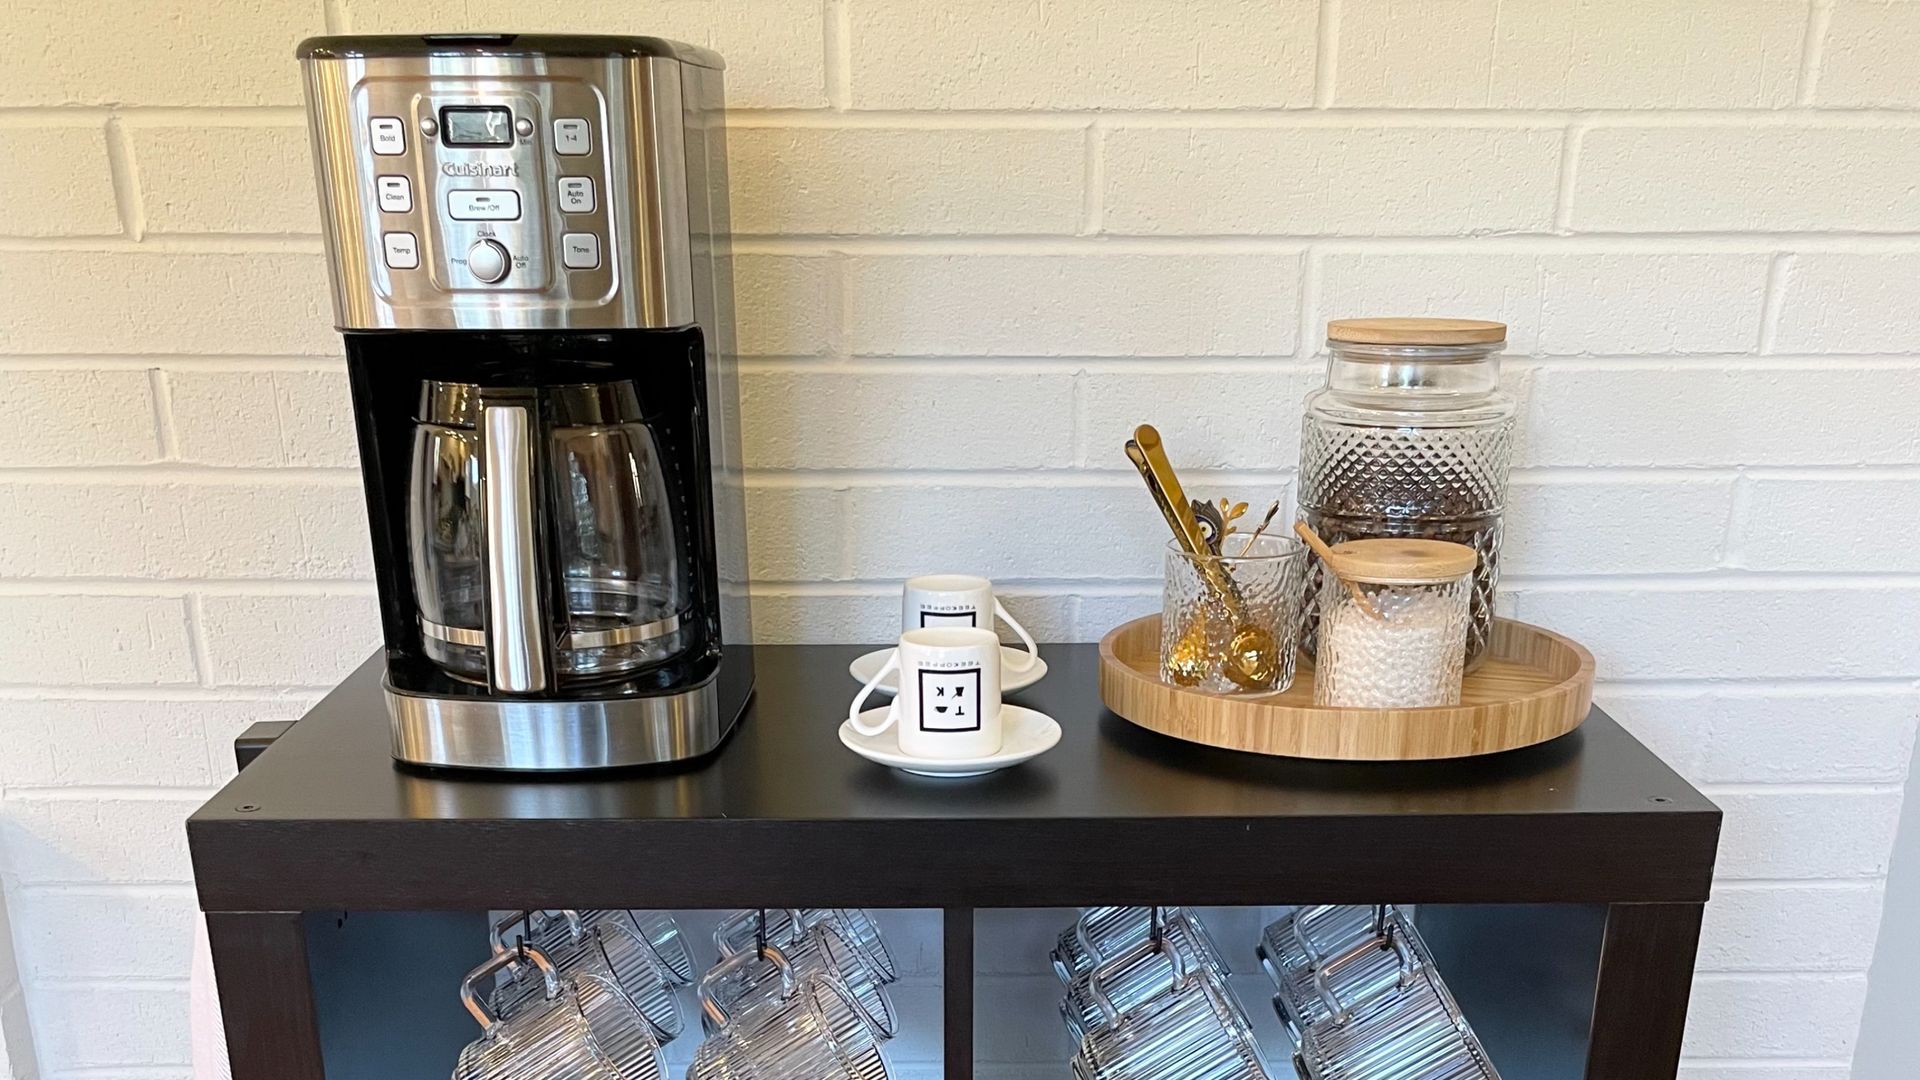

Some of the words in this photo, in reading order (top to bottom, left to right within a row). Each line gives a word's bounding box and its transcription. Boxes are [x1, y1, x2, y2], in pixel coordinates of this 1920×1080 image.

[379, 134, 396, 142] Bold
[442, 162, 520, 177] Cuisinart
[385, 193, 405, 201] Clean
[567, 190, 584, 198] Auto
[392, 246, 411, 255] Temp
[450, 257, 468, 266] Prog
[936, 686, 945, 697] K
[955, 705, 965, 716] T
